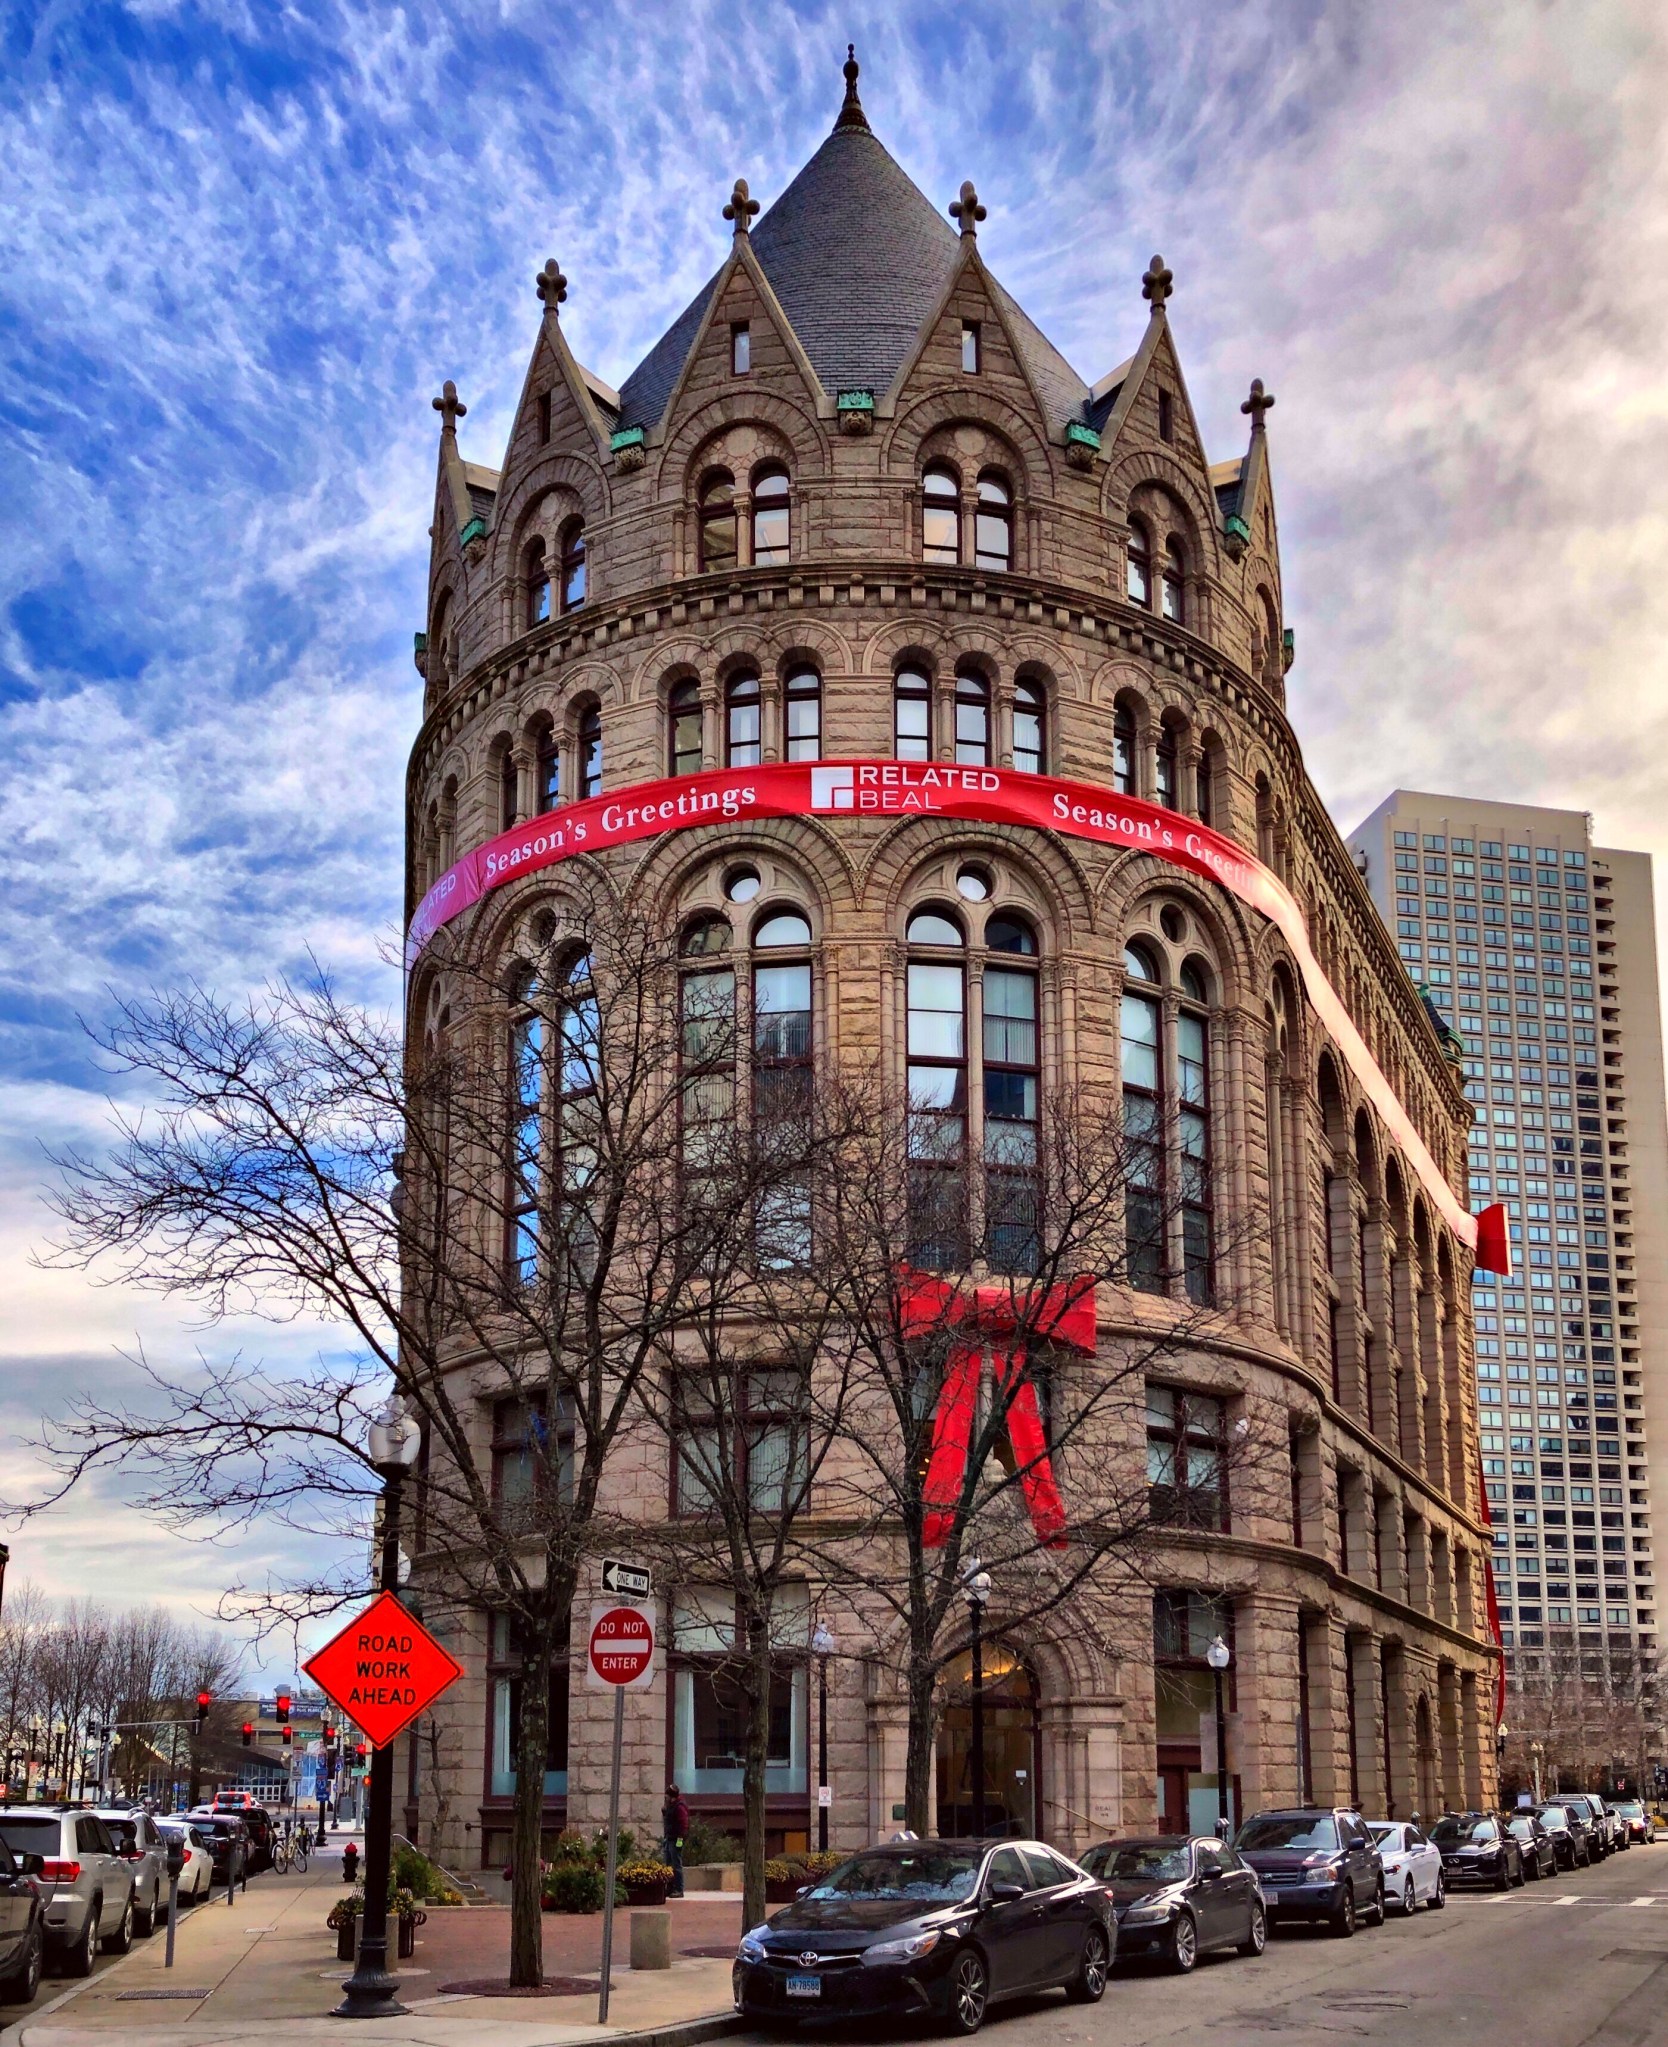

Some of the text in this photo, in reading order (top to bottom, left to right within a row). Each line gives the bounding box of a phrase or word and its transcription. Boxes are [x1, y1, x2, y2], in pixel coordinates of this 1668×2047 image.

[859, 766, 1000, 792] RELATED
[859, 791, 942, 810] BEAL
[1052, 793, 1173, 847] Season's
[485, 785, 756, 879] Season's Greetings
[616, 1572, 646, 1589] ONE WAY
[600, 1622, 644, 1634] DO NOT
[358, 1635, 413, 1653] ROAD
[356, 1661, 411, 1679] WORK
[602, 1657, 638, 1669] ENTER
[348, 1687, 416, 1705] AHEAD
